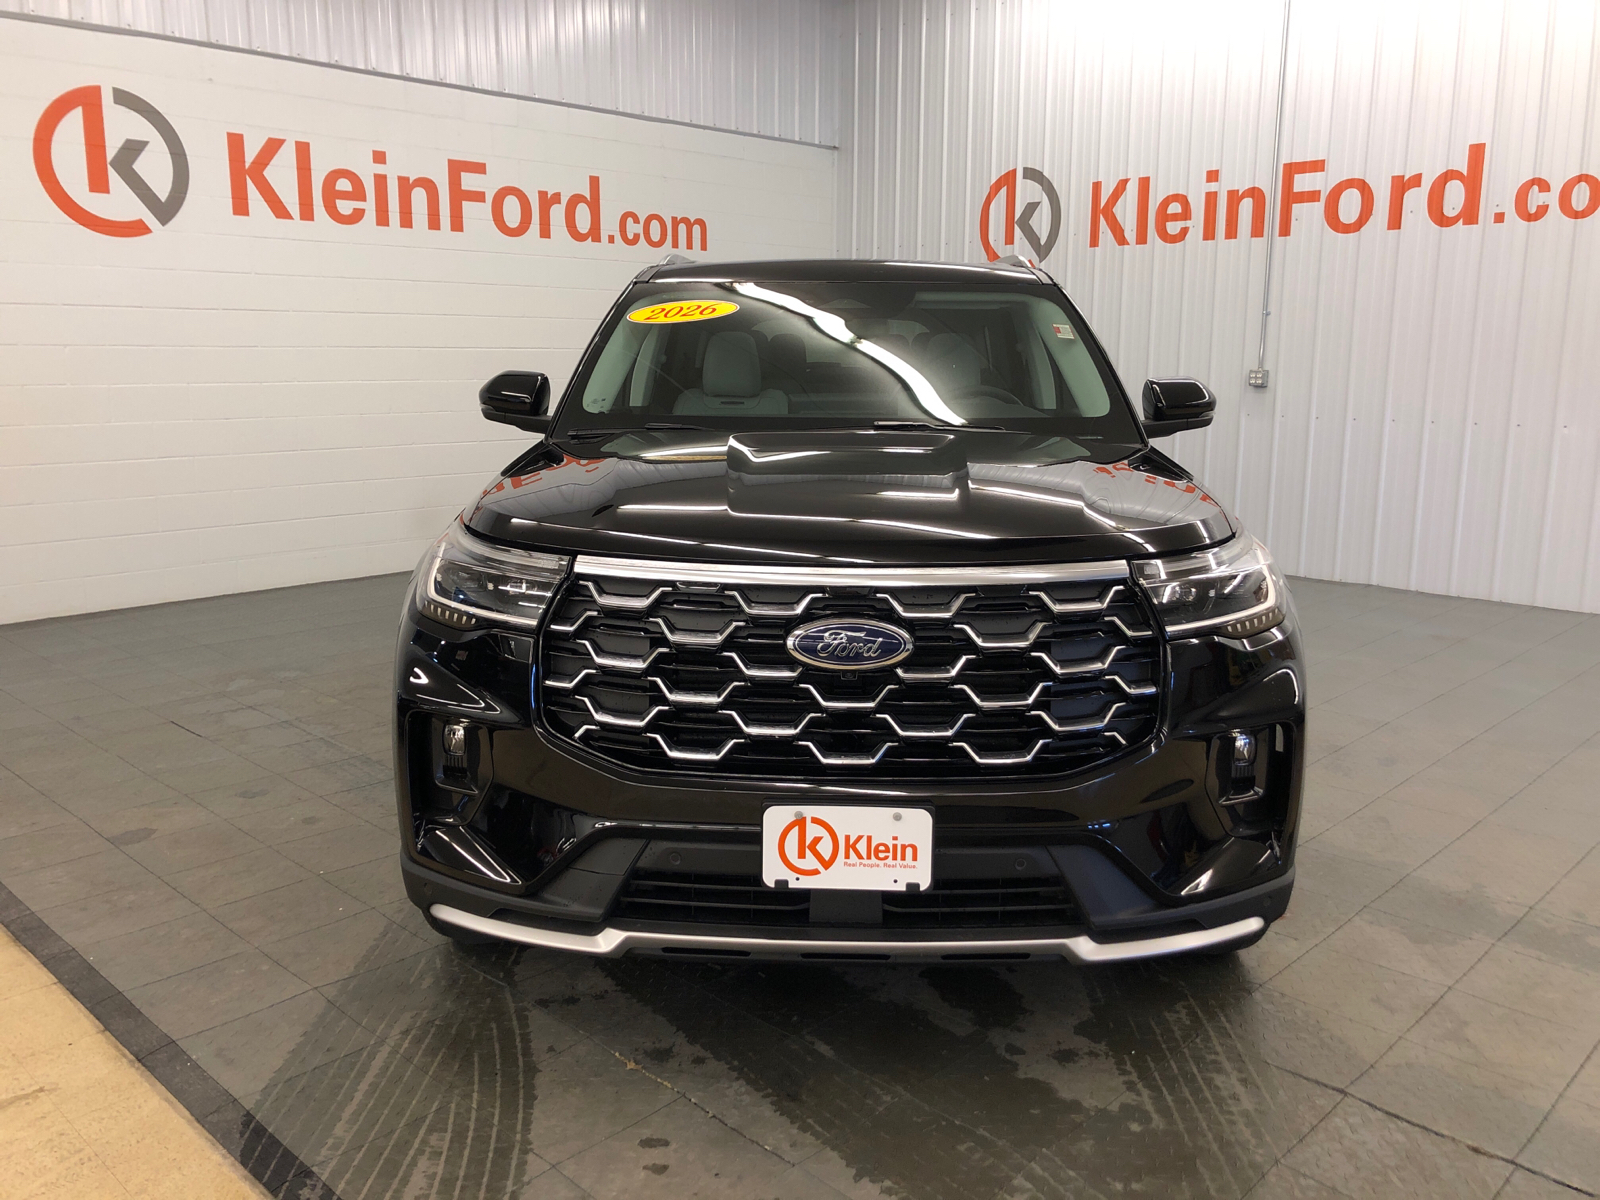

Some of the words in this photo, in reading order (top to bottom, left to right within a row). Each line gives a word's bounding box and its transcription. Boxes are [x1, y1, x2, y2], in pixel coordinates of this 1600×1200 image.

[226, 131, 708, 252] KleinFord.com
[645, 301, 718, 321] 2026
[816, 629, 883, 657] Ford
[844, 834, 918, 862] Klein
[858, 861, 881, 869] People.
